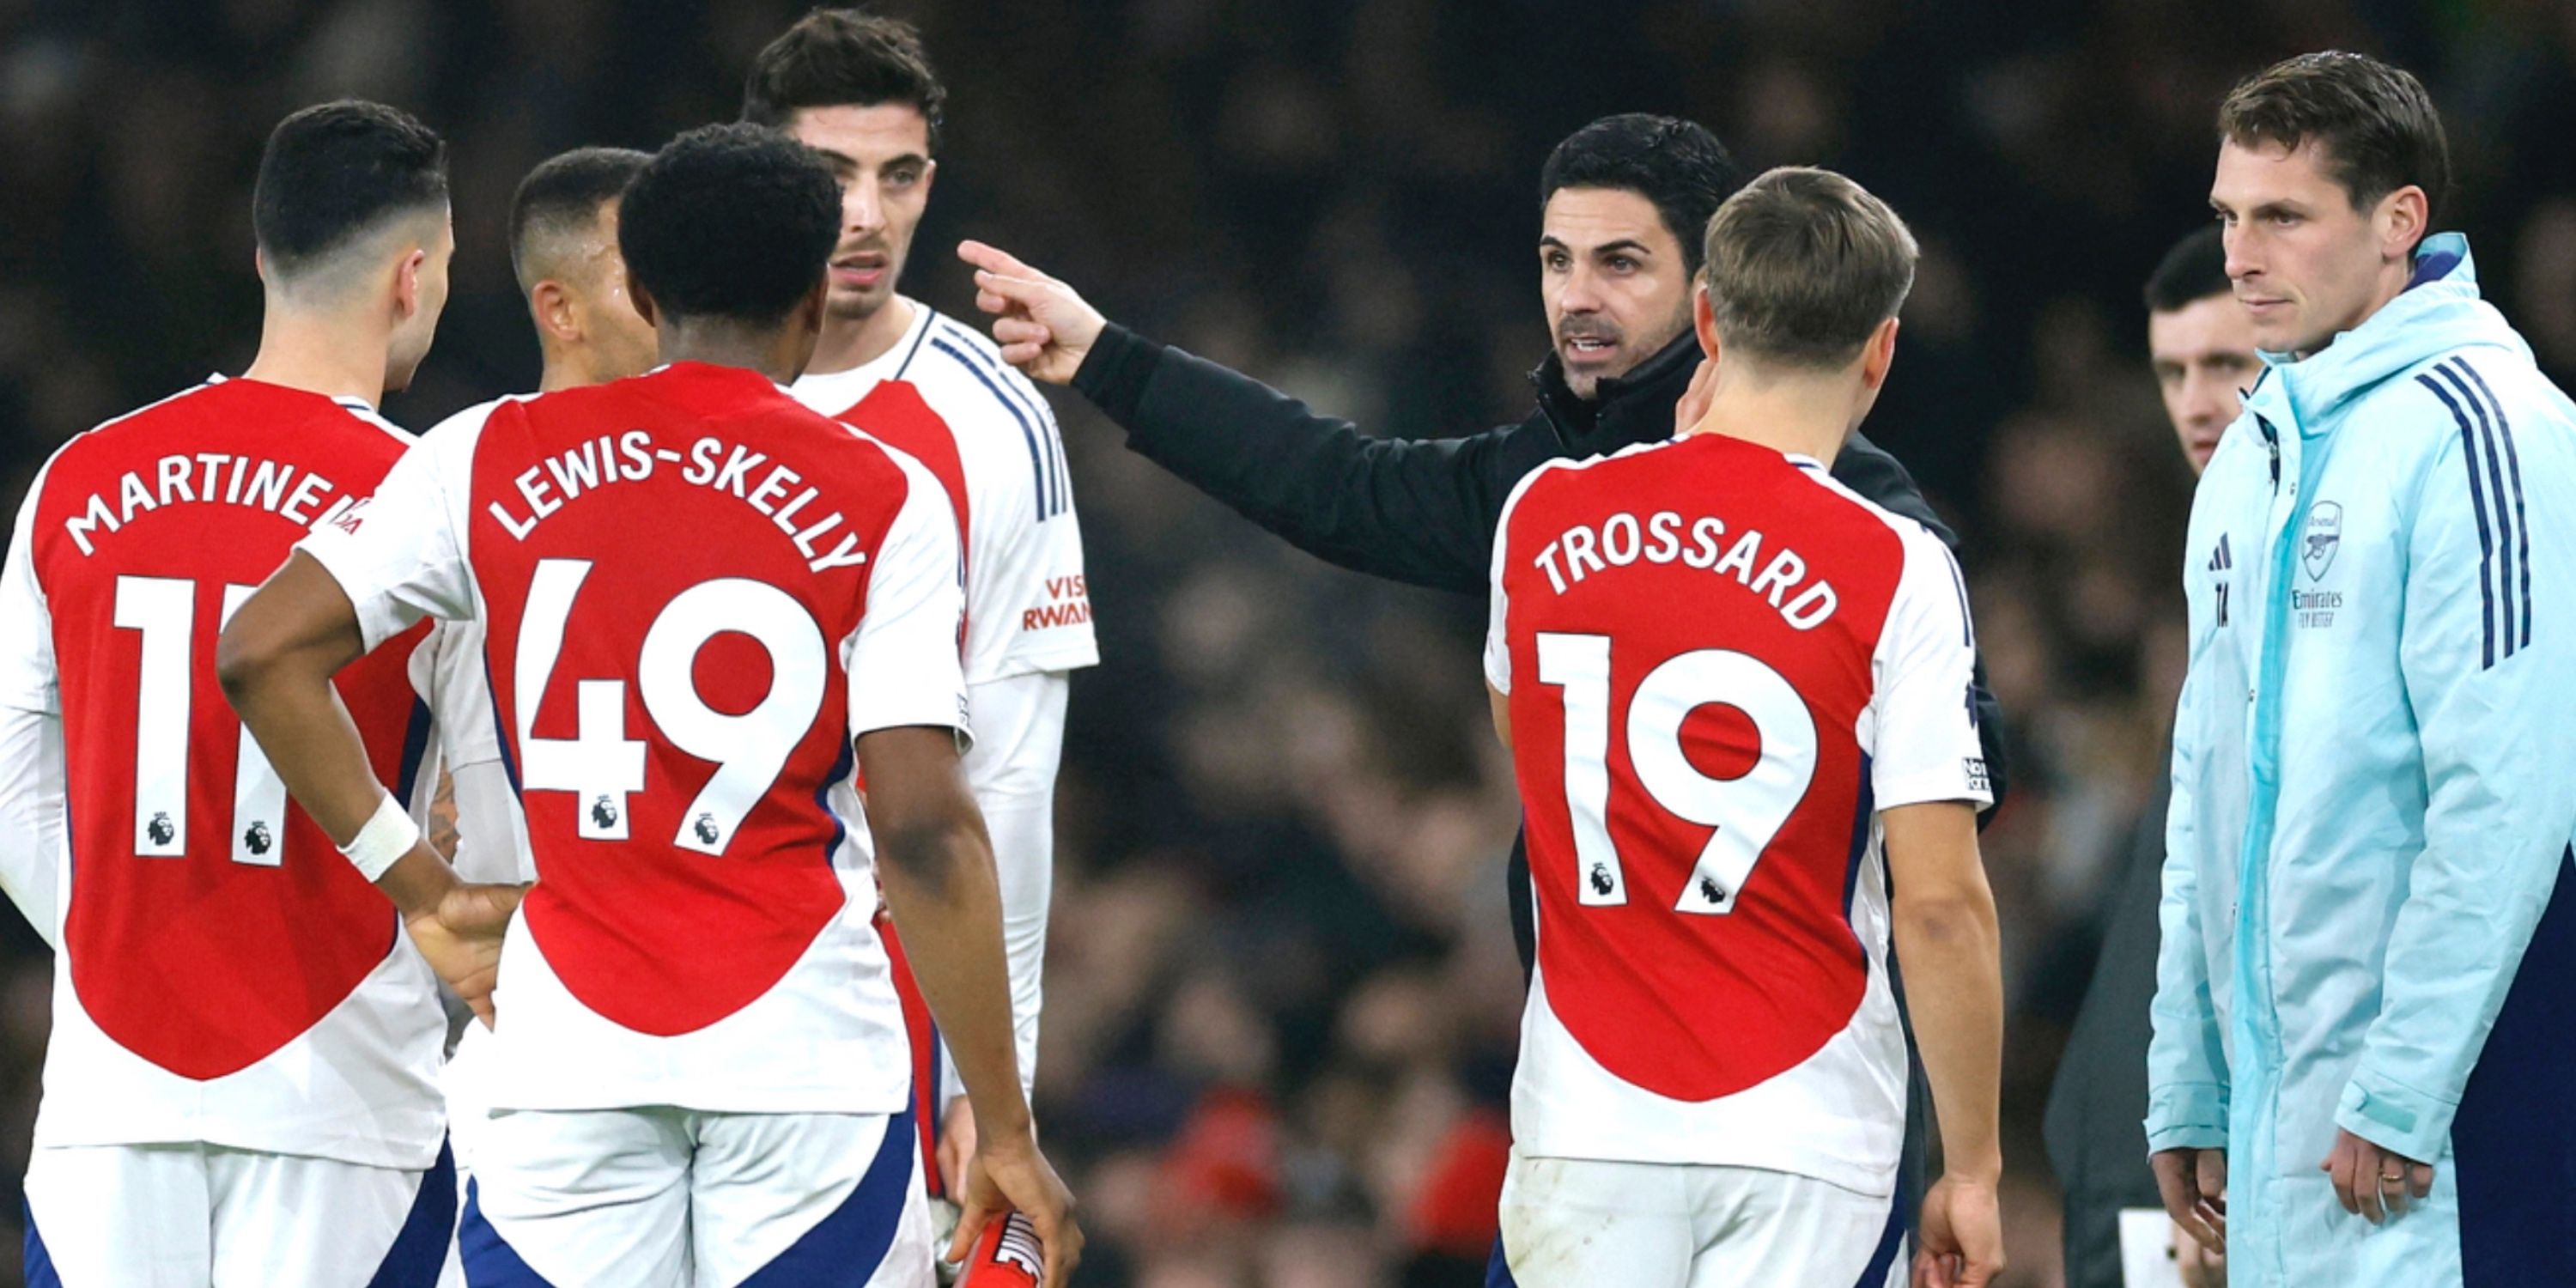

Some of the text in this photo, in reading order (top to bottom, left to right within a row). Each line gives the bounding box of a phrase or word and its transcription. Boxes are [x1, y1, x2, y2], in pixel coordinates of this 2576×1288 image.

[488, 430, 867, 574] LEWIS-SKELLY
[1534, 511, 1838, 631] TROSSARD
[513, 558, 829, 857] 49
[1534, 631, 1820, 916] 19
